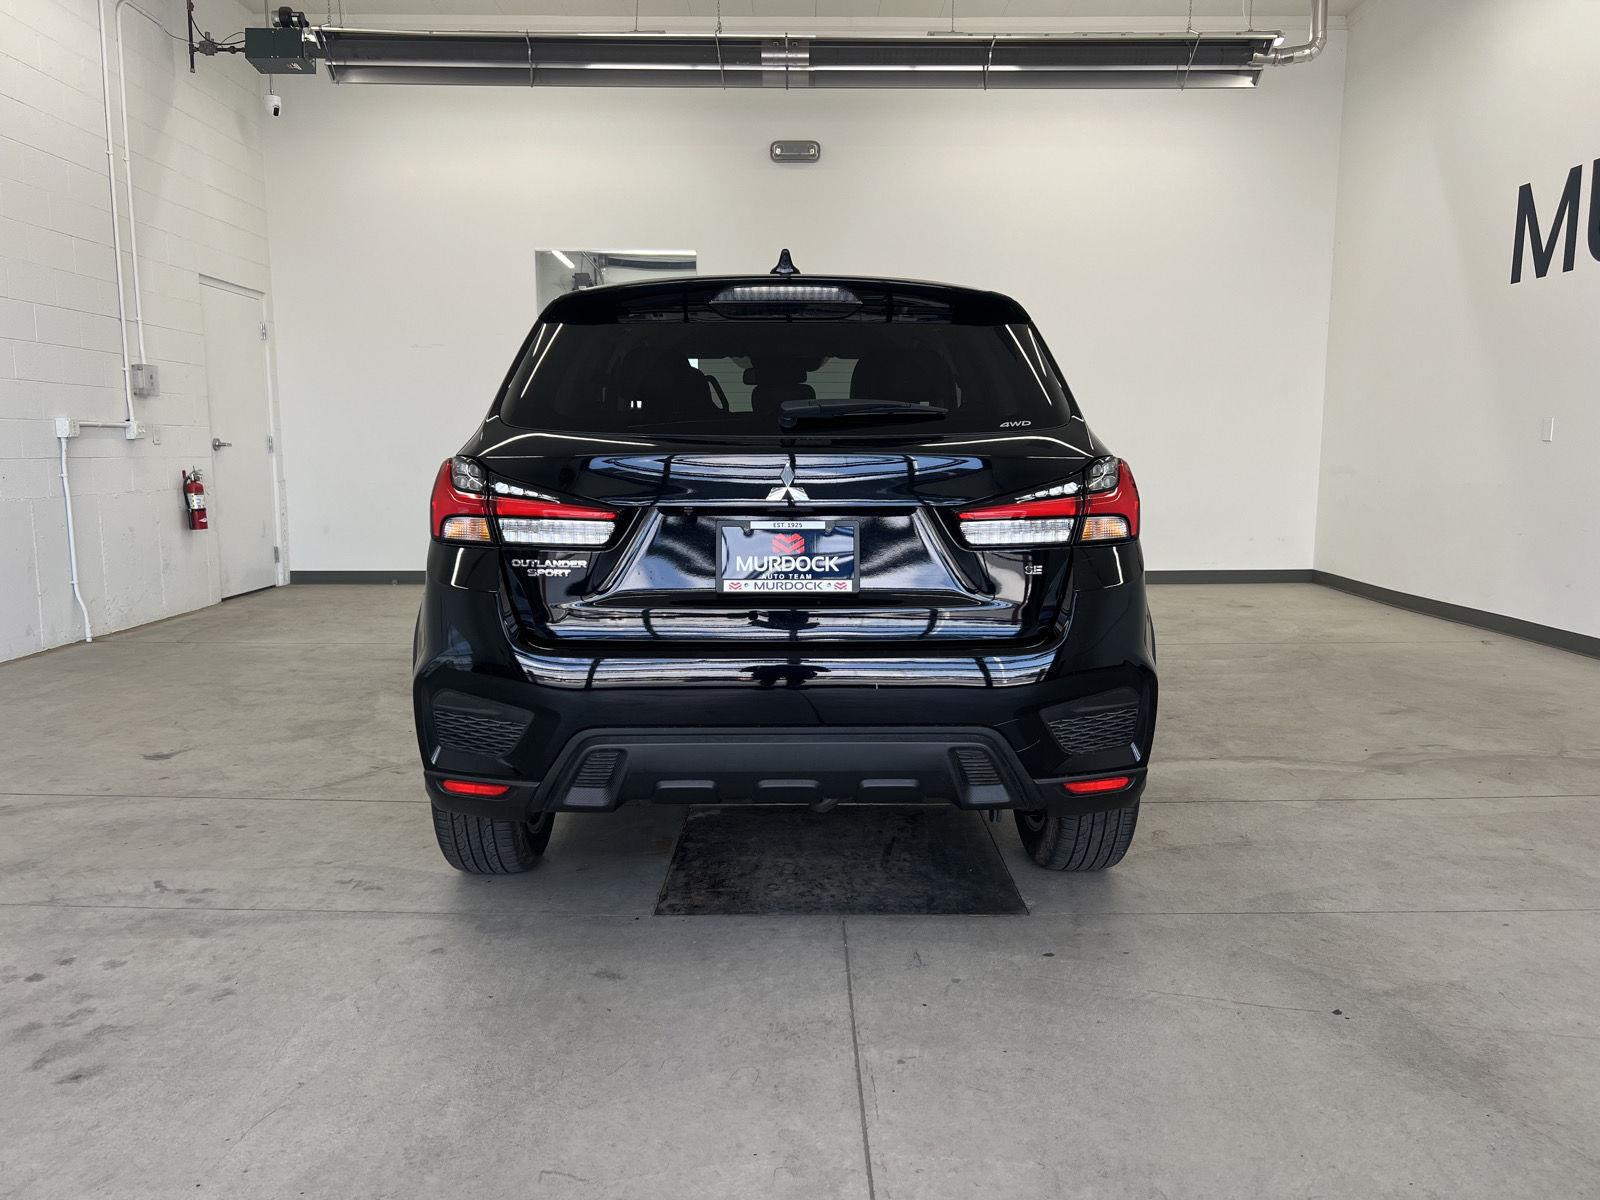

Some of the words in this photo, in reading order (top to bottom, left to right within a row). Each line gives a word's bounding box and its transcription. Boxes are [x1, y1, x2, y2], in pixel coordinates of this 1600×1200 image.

[1510, 157, 1600, 285] M
[999, 420, 1032, 428] 4WD
[511, 559, 588, 568] OUTLANDER
[736, 555, 840, 572] MURDOCK
[527, 568, 571, 577] SPORT
[1024, 565, 1043, 575] SE
[754, 581, 823, 590] MURDOCK
